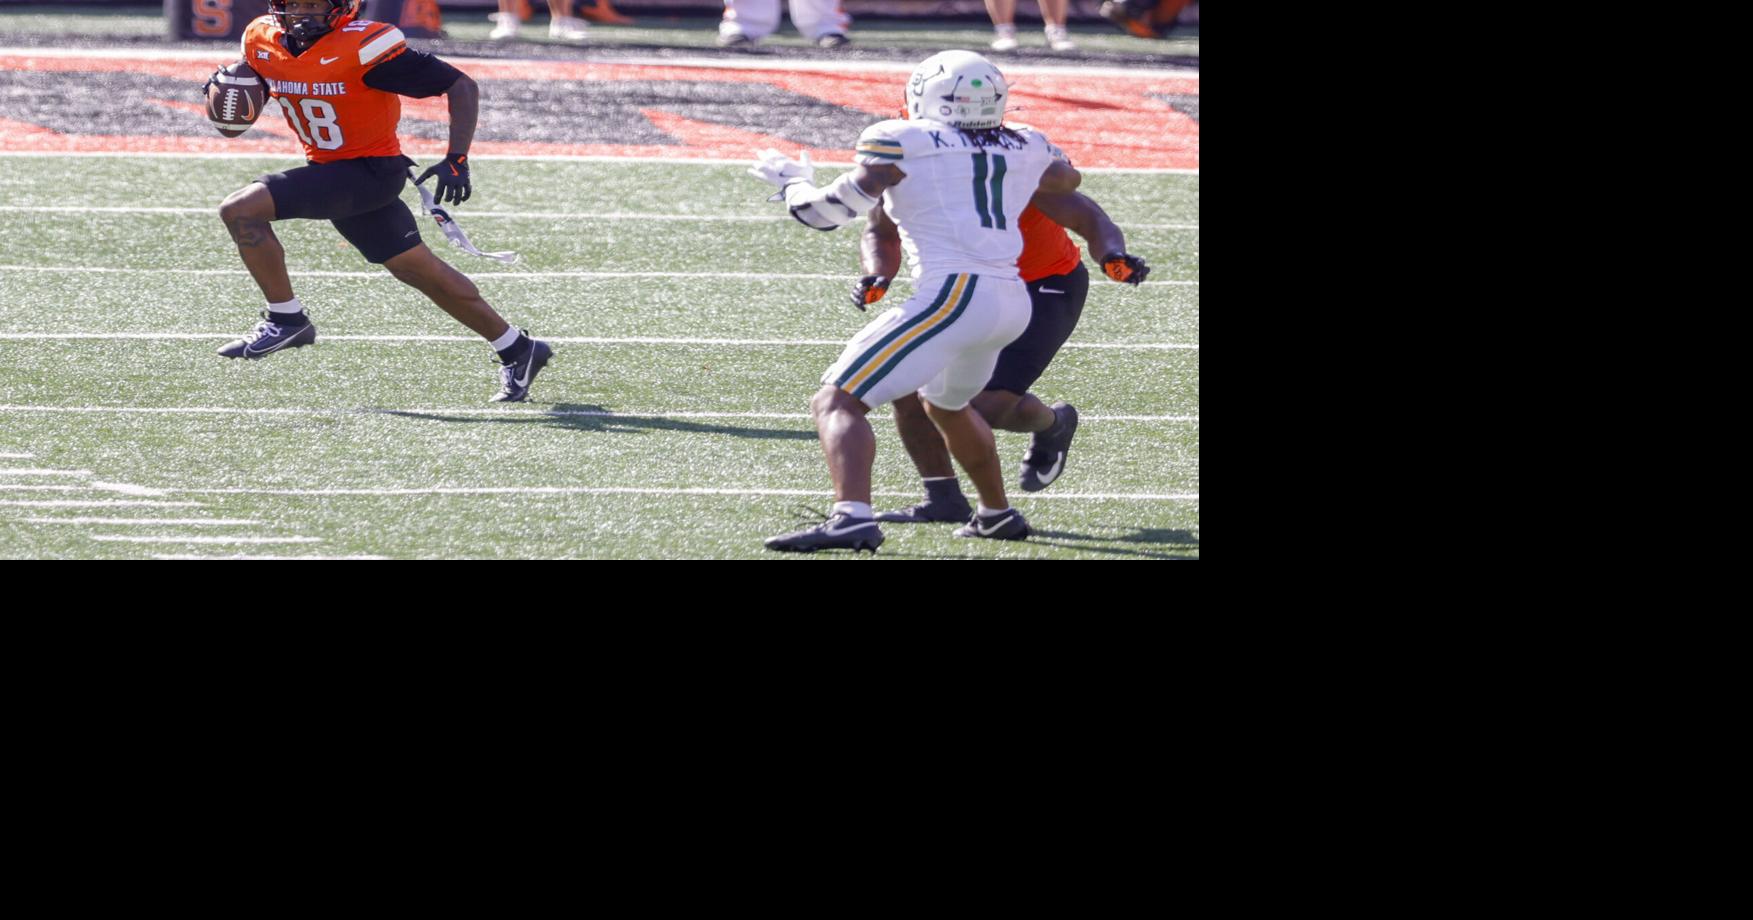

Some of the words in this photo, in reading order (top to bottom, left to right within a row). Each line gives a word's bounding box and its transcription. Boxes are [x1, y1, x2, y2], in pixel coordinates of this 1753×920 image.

[191, 0, 232, 37] S
[312, 82, 346, 96] STATE
[278, 96, 343, 150] 18
[928, 130, 955, 149] K.
[971, 152, 1007, 231] 11
